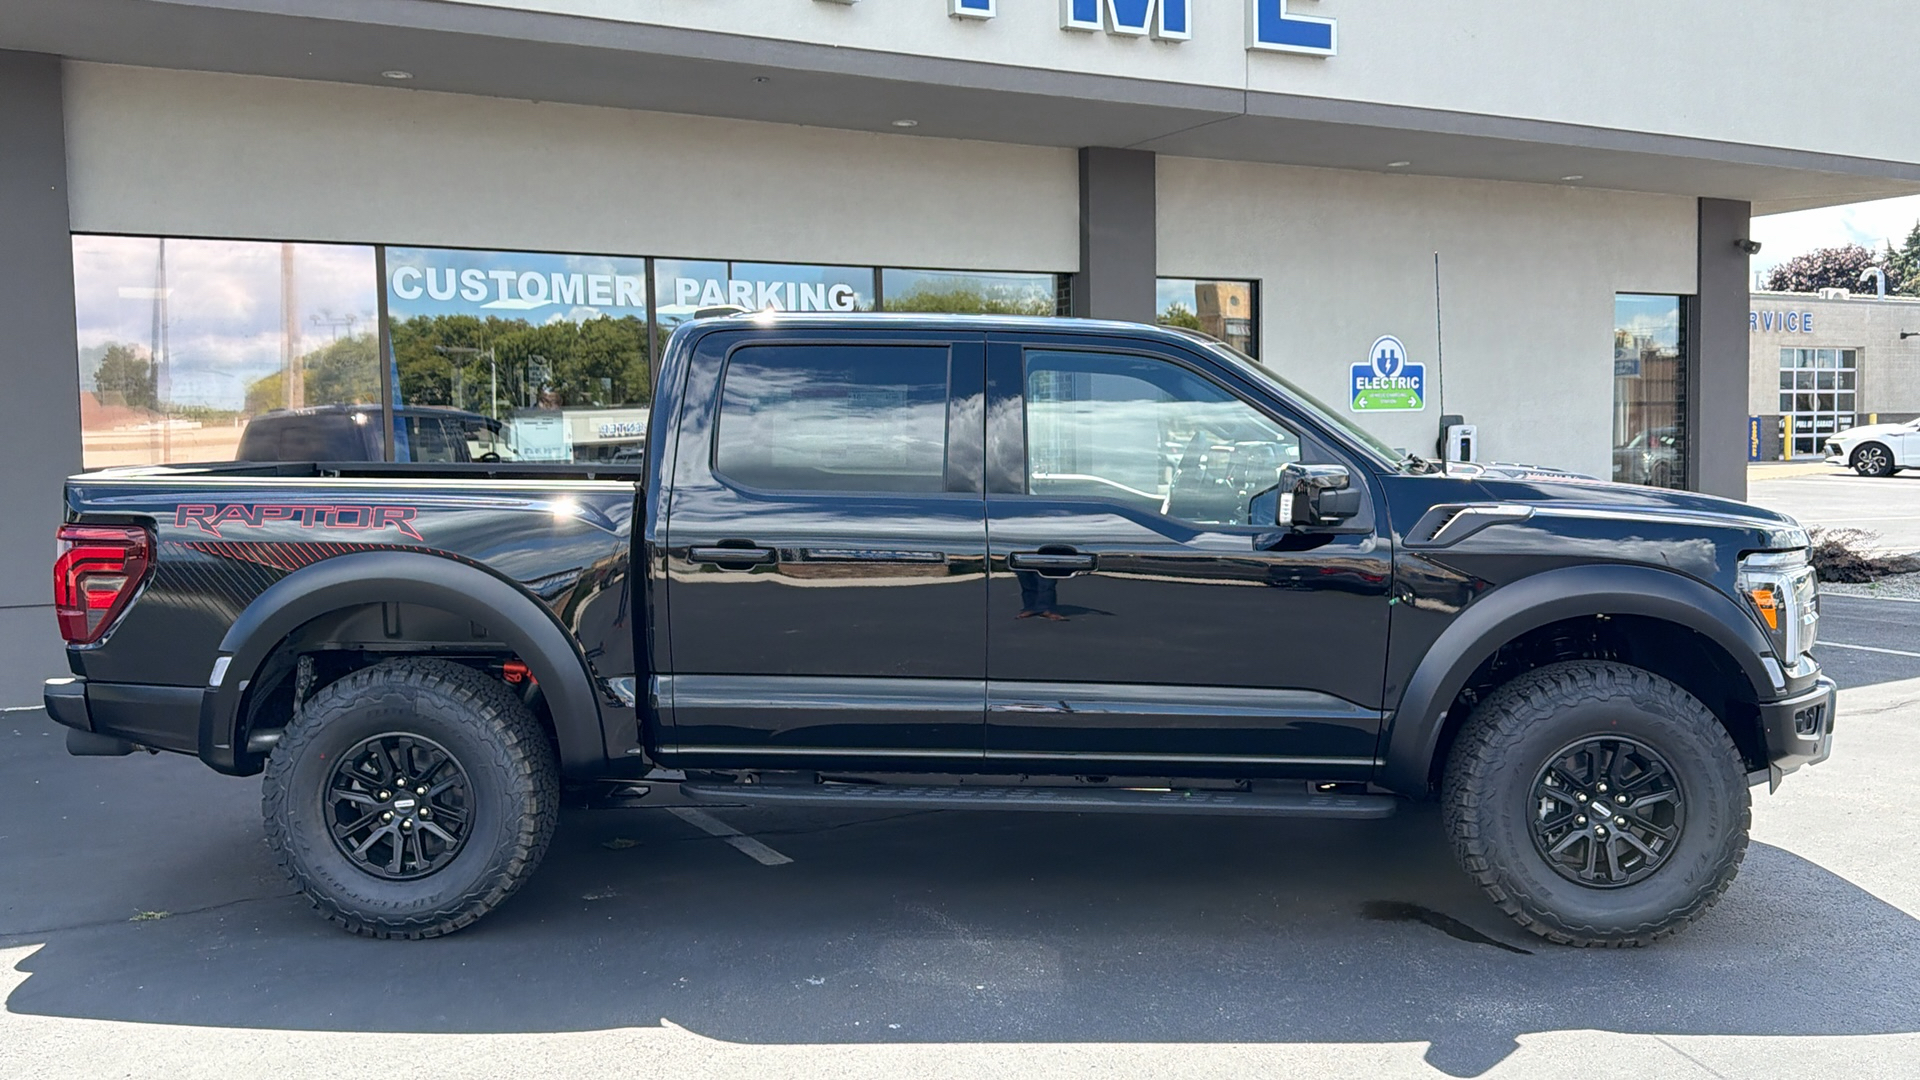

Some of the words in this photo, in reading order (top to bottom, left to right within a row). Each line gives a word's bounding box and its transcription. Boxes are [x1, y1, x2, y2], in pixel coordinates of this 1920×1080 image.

[391, 266, 643, 308] CUSTOMER
[675, 276, 855, 313] PARKING
[1356, 376, 1420, 389] ELECTRIC
[175, 504, 424, 541] RAPTOR
